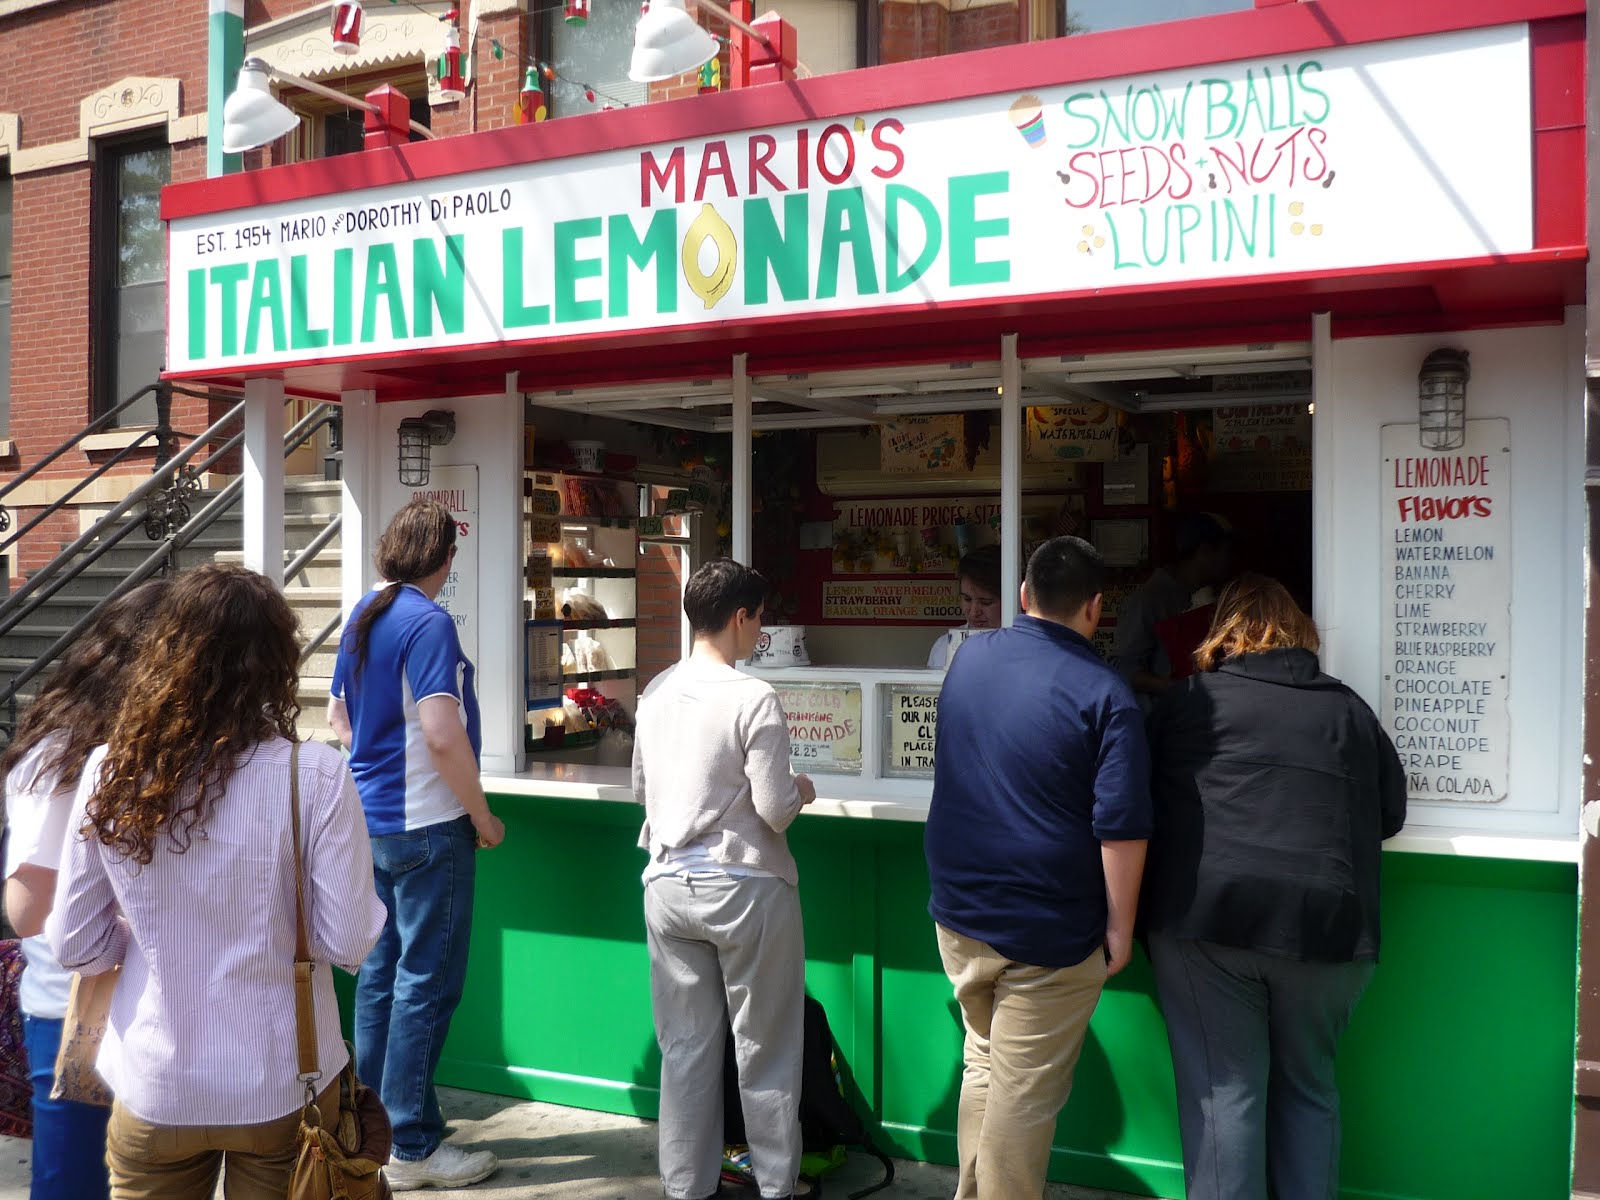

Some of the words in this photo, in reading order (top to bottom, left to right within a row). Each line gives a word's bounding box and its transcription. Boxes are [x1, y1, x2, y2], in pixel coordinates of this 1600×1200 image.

[1063, 81, 1193, 149] SNOW
[1200, 60, 1330, 140] BALLS
[640, 117, 905, 207] MARIO'S
[1065, 142, 1193, 209] SEEDS
[1209, 127, 1327, 193] NUTS
[197, 231, 226, 255] EST.
[235, 225, 271, 249] 1954
[281, 216, 326, 243] MARIO
[331, 213, 345, 235] AND
[346, 201, 422, 233] DOROTHY
[453, 188, 511, 218] PAOLO
[1104, 193, 1275, 270] LUPINI
[187, 234, 465, 360] ITALIAN
[501, 171, 1010, 329] LEMONADE
[1038, 427, 1115, 440] WATERMELON
[1395, 456, 1490, 488] LEMONADE
[849, 506, 918, 527] LEMONADE
[922, 505, 965, 526] PRICES
[974, 504, 1002, 524] SIZ
[1397, 495, 1493, 523] Flavors
[1395, 528, 1443, 543] LEMON
[1395, 546, 1494, 561] WATERMELON
[1395, 565, 1450, 581] BANANA
[826, 586, 865, 596] LEMON
[872, 586, 952, 596] WATERMELON
[1395, 584, 1455, 599] CHERRY
[825, 595, 902, 605] STRAWBERRY
[911, 595, 962, 605] PINEAPP
[825, 606, 869, 616] BANANA
[873, 606, 918, 616] ORANGE
[923, 606, 964, 616] CHOCO
[1395, 603, 1431, 618] LIME
[1395, 621, 1488, 637] STRAWBERRY
[1395, 659, 1457, 675] ORANGE
[1395, 679, 1492, 696] CHOCOLATE
[808, 691, 841, 709] COLD
[901, 695, 939, 708] PLEASE
[1394, 697, 1486, 714] PINEAPPLE
[901, 711, 920, 723] OUR
[924, 711, 937, 723] NE
[1394, 716, 1481, 734] COCONUT
[788, 718, 857, 742] MONADE
[1395, 735, 1489, 752] CANTALOPE
[901, 756, 911, 766] IN
[915, 756, 936, 768] TRA
[1397, 752, 1463, 770] GRAPE
[1406, 771, 1430, 792] ÑA
[1436, 775, 1494, 795] COLADA
